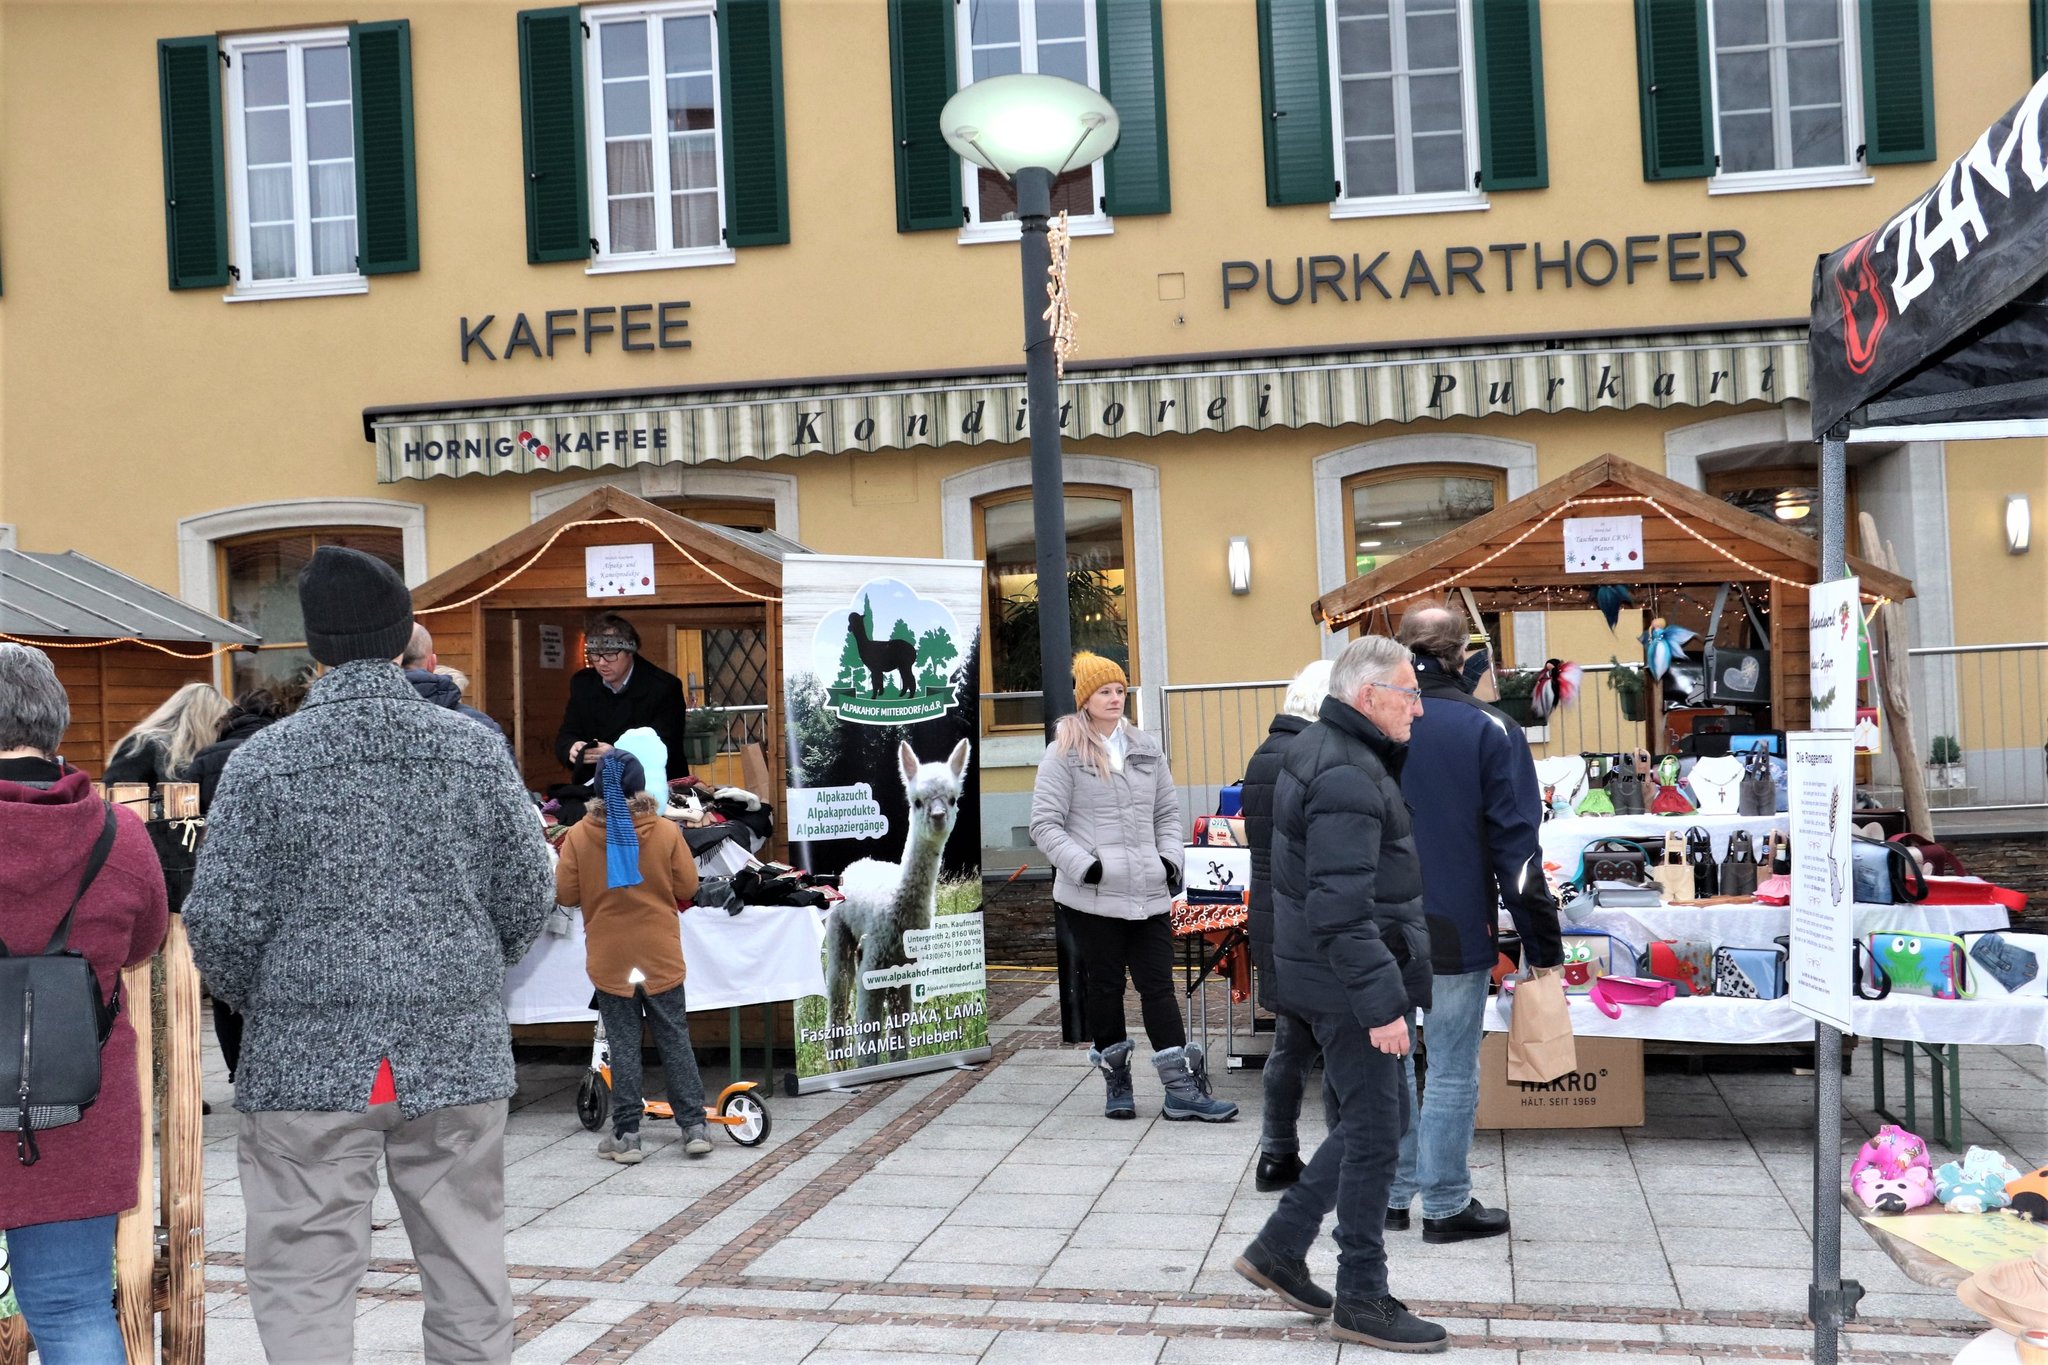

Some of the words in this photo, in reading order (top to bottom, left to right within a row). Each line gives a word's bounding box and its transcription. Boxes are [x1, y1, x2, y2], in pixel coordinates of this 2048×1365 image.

[1222, 229, 1749, 309] PURKARTHOFER
[460, 301, 692, 363] KAFFEE
[791, 383, 1273, 446] Konditorei
[1426, 362, 1776, 409] Purkart
[404, 436, 515, 462] HORNIG
[555, 428, 668, 453] KAFFEE
[841, 702, 880, 716] ALPAKAHOF
[1796, 751, 1804, 763] Die
[816, 788, 868, 805] Alpakazucht
[807, 804, 876, 821] Alpakaprodukte
[796, 819, 885, 838] Alpakaspaziergänge
[935, 922, 950, 930] Fam.
[951, 919, 981, 928] Kaufmann
[907, 933, 944, 943] Untergreith
[951, 930, 967, 938] 8160
[867, 962, 982, 985] www.alpakahof-mitterdorf.at
[800, 1019, 881, 1043] Faszination
[885, 1008, 942, 1030] ALPAKA,
[945, 1002, 984, 1021] LAMA
[826, 1045, 853, 1061] und
[857, 1036, 906, 1057] KAMEL
[909, 1025, 963, 1048] erleben!
[1521, 1096, 1546, 1106] HÄLT.
[1549, 1097, 1569, 1106] SEIT
[1573, 1097, 1596, 1106] 1969
